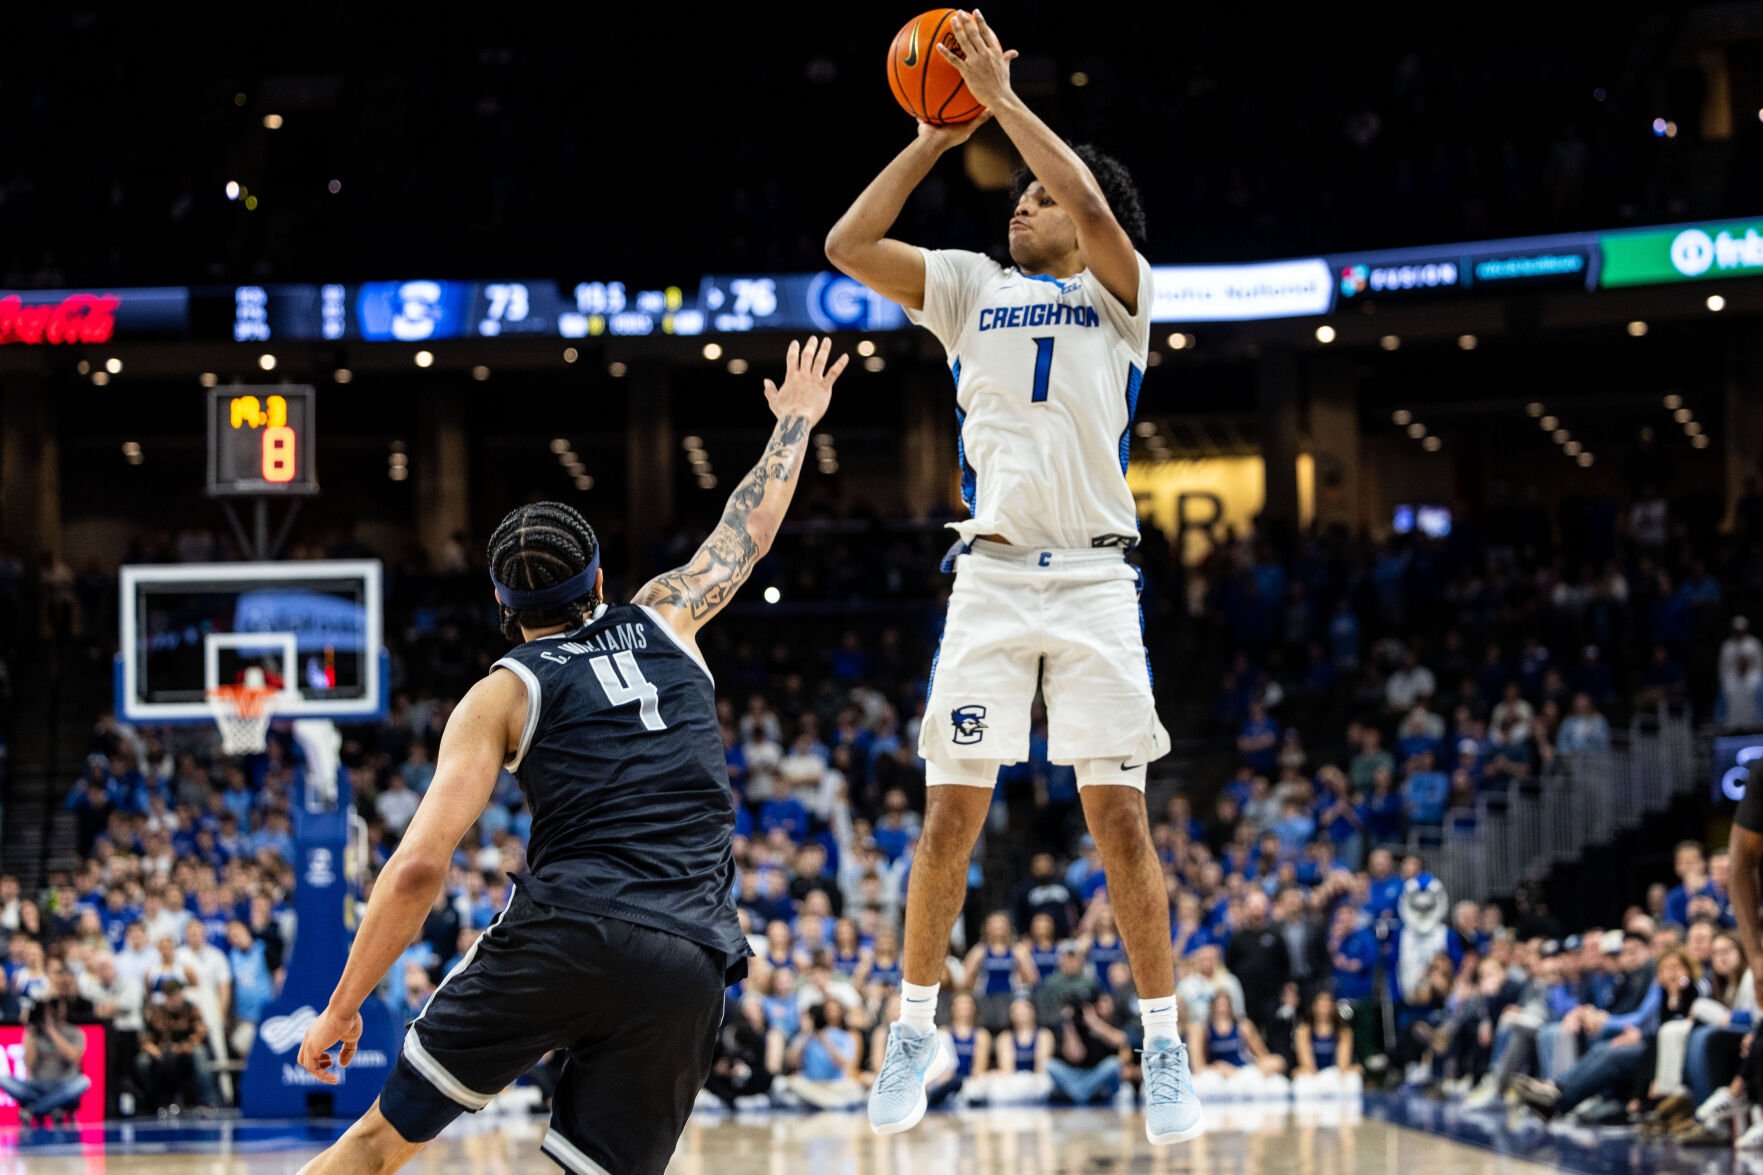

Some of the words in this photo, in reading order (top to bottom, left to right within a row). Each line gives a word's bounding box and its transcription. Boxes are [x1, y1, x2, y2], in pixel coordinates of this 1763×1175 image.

[979, 303, 1099, 332] CREIGHTON
[1031, 336, 1055, 403] 1
[262, 425, 296, 483] 8
[1038, 551, 1052, 567] C
[589, 649, 668, 731] 4
